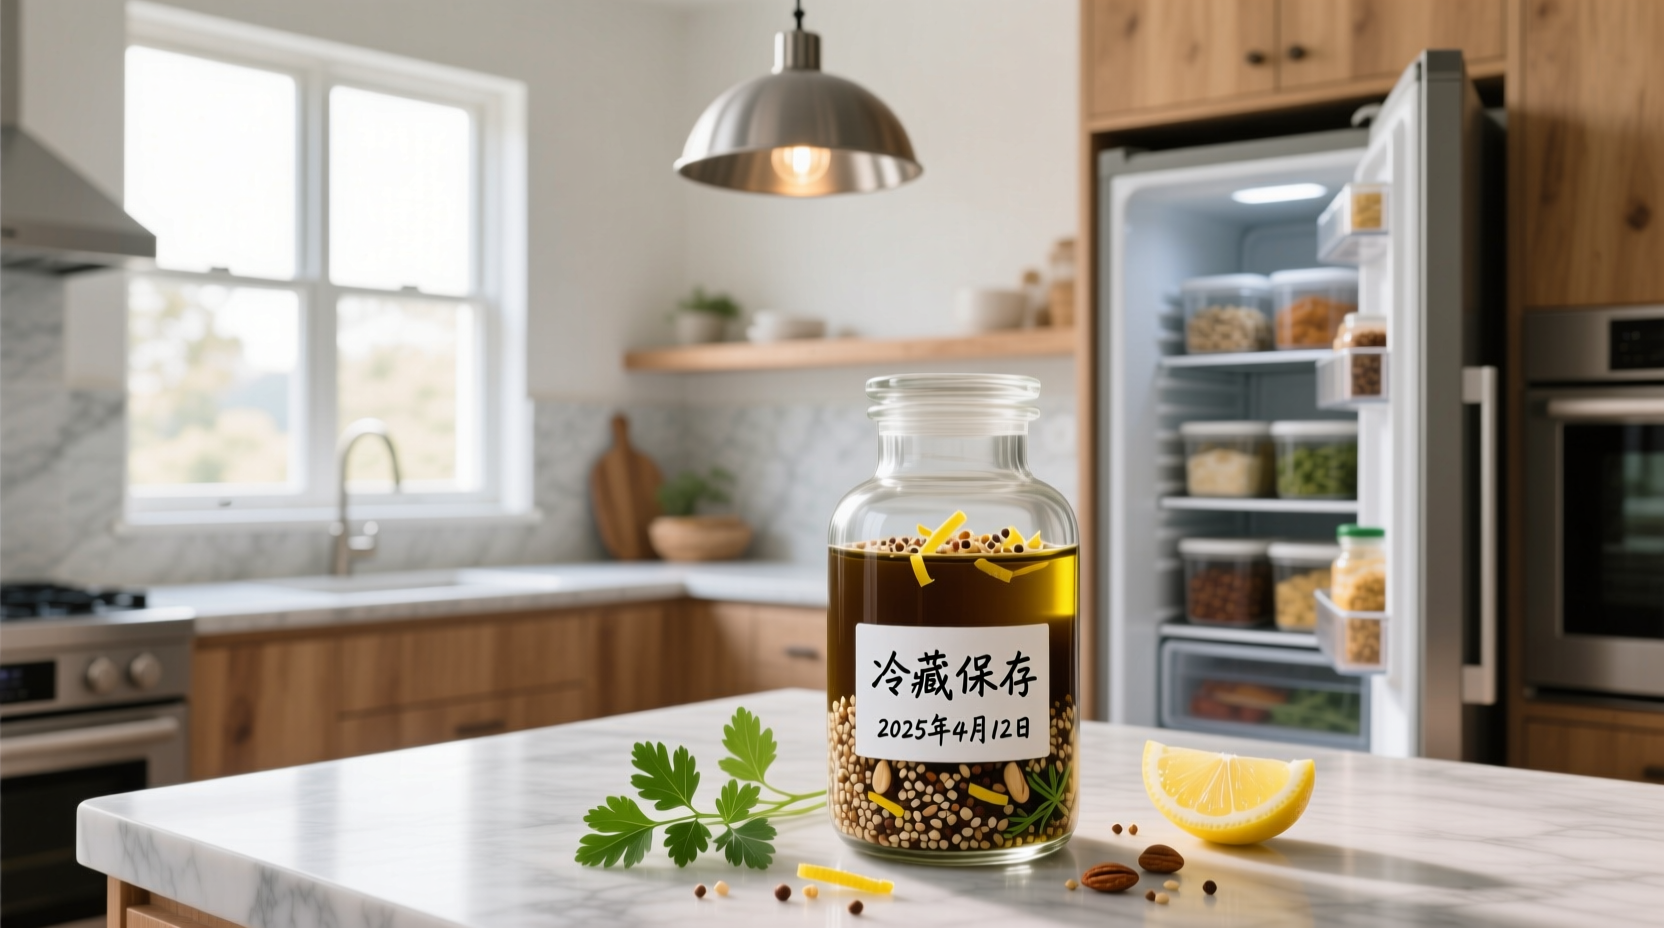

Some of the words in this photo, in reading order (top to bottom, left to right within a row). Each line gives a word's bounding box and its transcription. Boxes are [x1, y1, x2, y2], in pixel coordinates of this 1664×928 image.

[871, 649, 1038, 701] 冷藏保存
[877, 713, 1030, 747] 2025年4月12日
